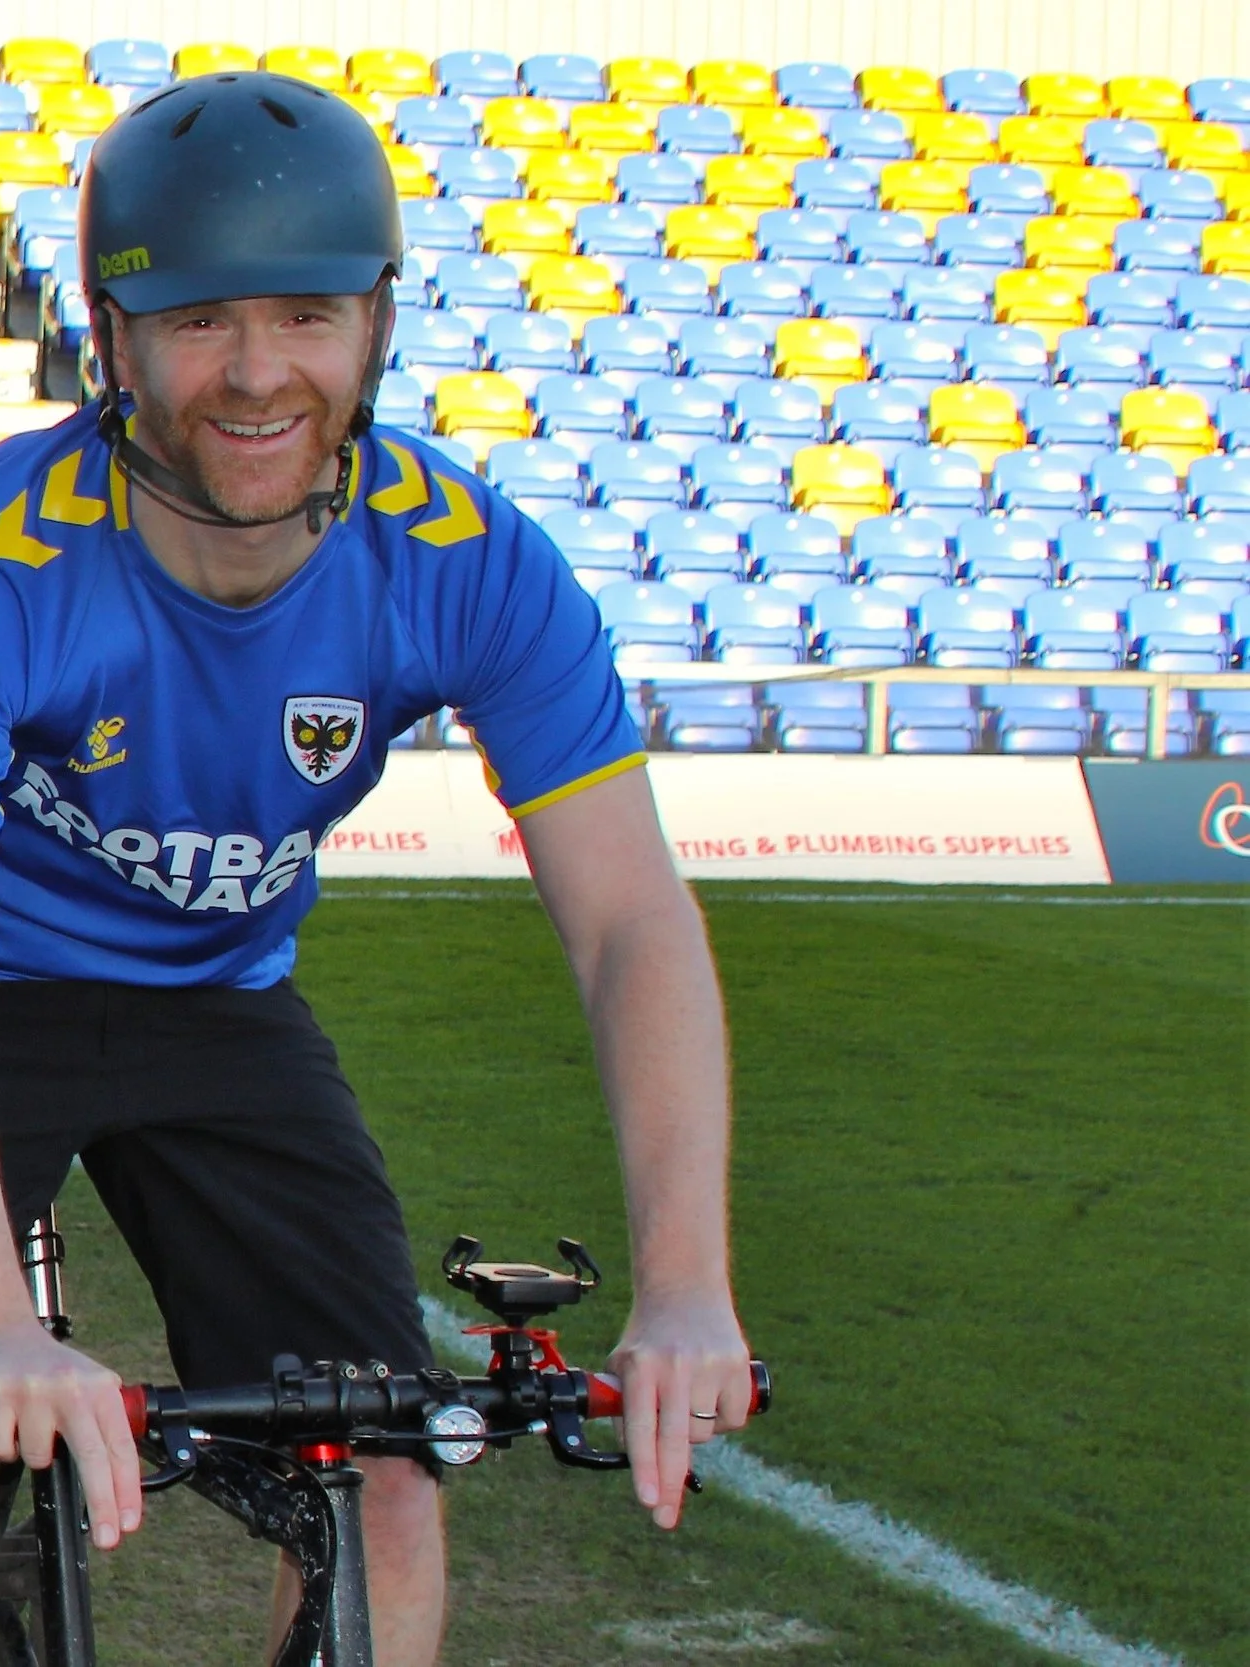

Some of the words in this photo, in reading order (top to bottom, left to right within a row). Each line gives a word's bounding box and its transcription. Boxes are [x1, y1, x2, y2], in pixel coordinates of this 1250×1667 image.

[97, 246, 151, 280] bern
[67, 747, 127, 774] hummel
[22, 760, 342, 878] FOOTBA
[756, 836, 777, 855] &
[785, 833, 936, 856] PLUMBING
[944, 835, 1071, 856] SUPPLIES
